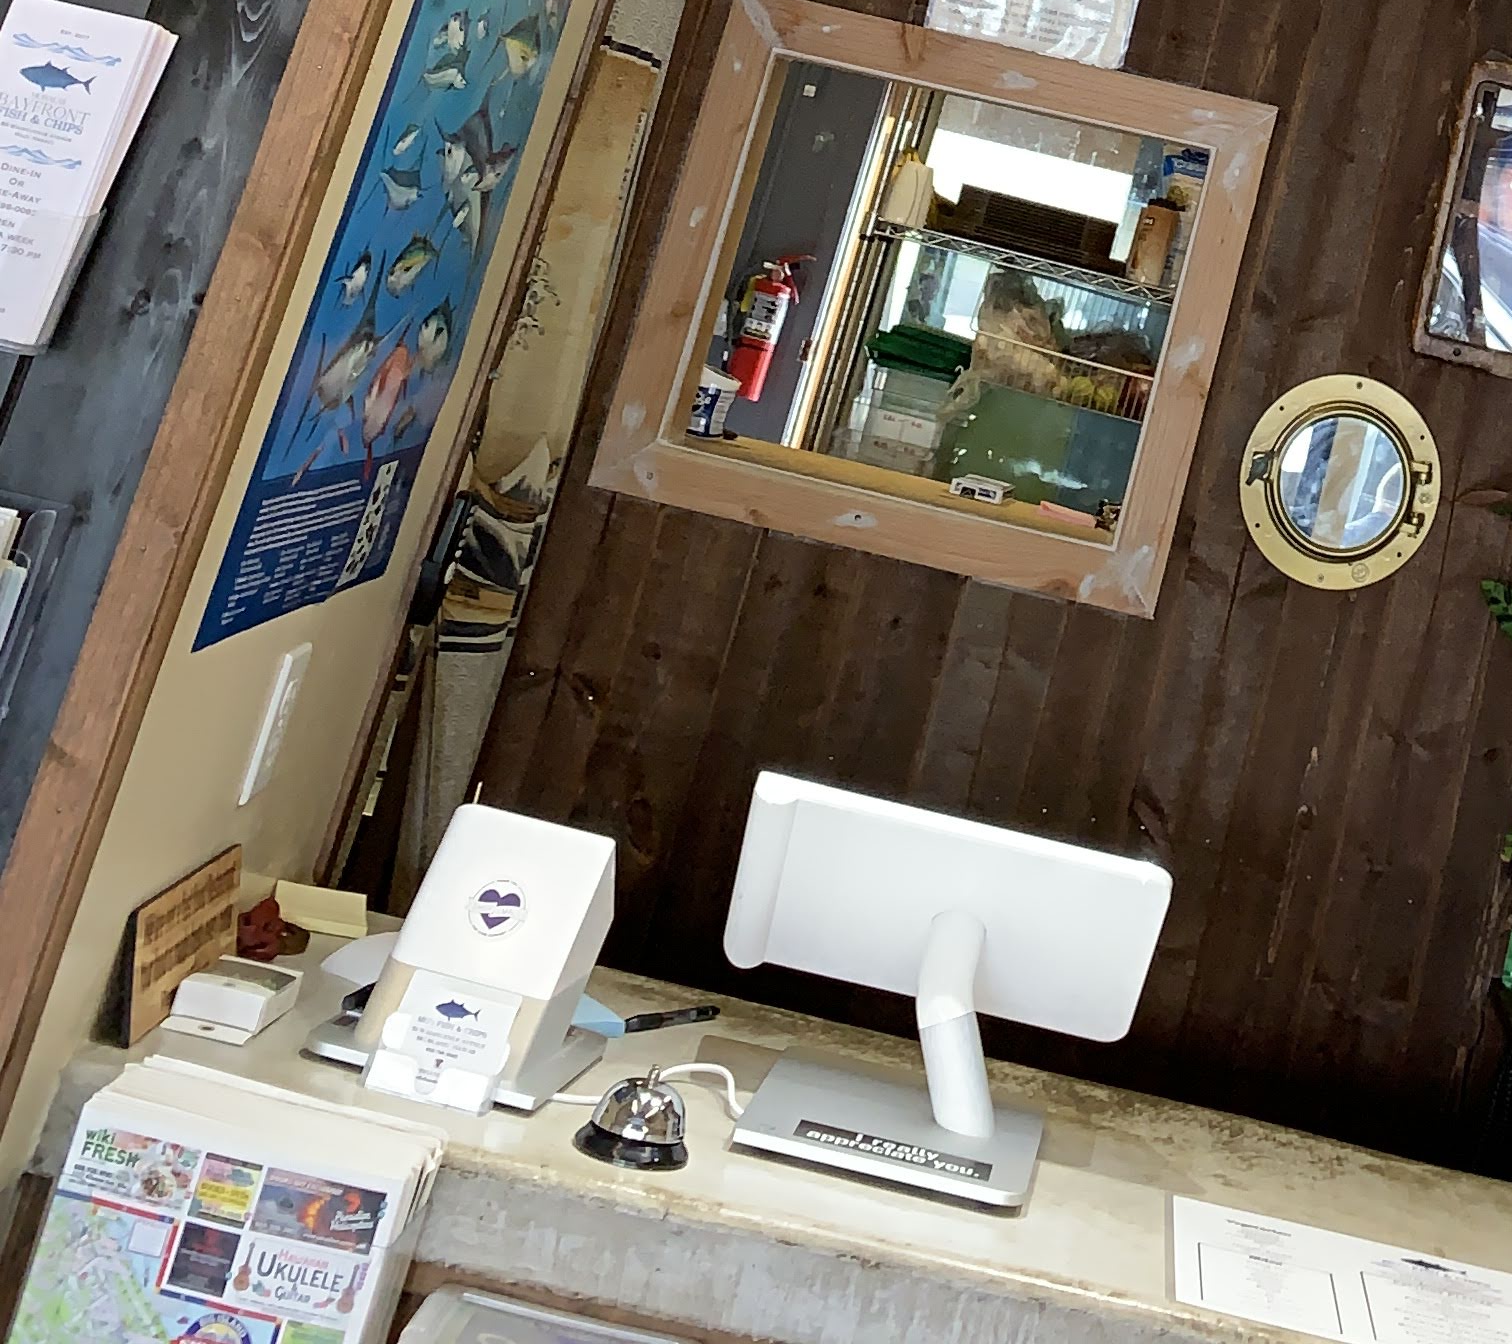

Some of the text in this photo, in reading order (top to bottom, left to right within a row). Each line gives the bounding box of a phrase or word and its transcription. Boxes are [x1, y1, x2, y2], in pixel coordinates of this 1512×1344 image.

[0, 92, 92, 125] BAYFRONT
[44, 117, 83, 136] CHIPS
[1, 162, 42, 178] DINE-IN
[80, 1141, 140, 1168] FRESH
[806, 1129, 981, 1179] appreciate you.
[872, 1138, 940, 1162] really
[256, 1251, 344, 1294] UKULELE
